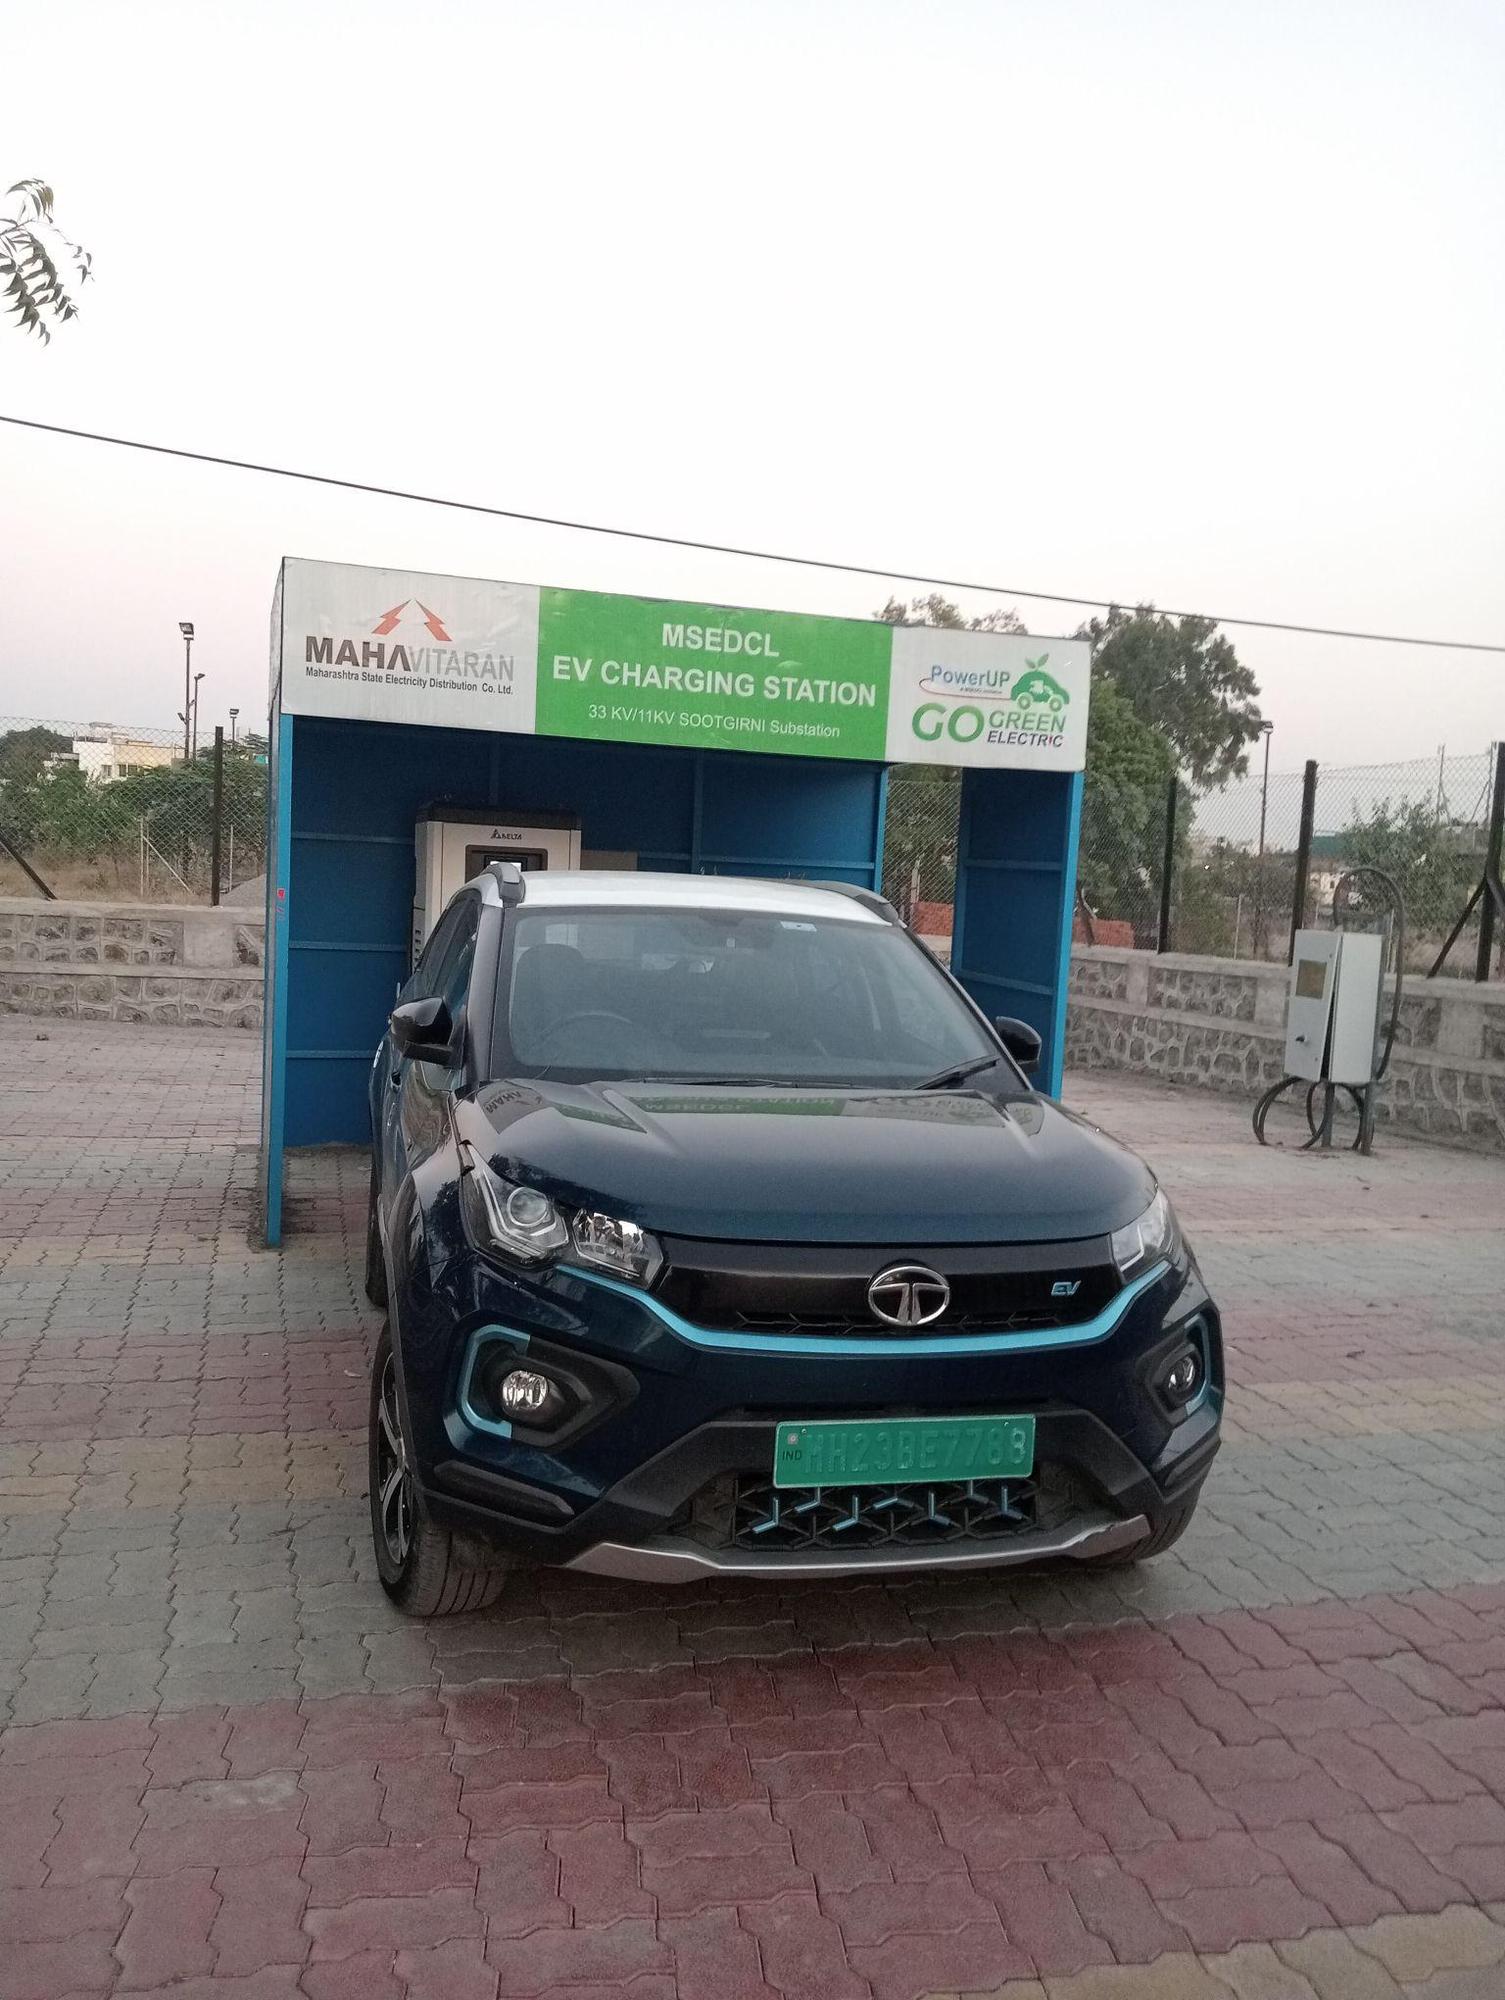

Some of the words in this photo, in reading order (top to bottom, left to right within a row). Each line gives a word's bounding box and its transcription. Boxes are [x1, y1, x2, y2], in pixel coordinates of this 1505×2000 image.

[662, 623, 780, 657] MSEDCL
[306, 636, 515, 682] MAHAVITARAN
[306, 666, 360, 681] Maharashtra
[361, 671, 383, 684] State
[386, 673, 427, 689] Electricity
[429, 677, 478, 692] Distribution
[482, 682, 496, 694] Co.
[498, 684, 514, 696] Ltd.
[553, 655, 593, 682] EV
[600, 660, 755, 697] CHARGING
[763, 676, 876, 707] STATION
[931, 665, 1011, 688] PowerUP
[588, 704, 607, 719] 33
[611, 706, 675, 726] KV/11KV
[679, 711, 766, 733] SOOTGIRNI
[770, 719, 841, 738] Substation
[911, 702, 985, 743] GO
[988, 709, 1067, 733] GREEN
[987, 730, 1065, 748] ELECTRIC
[1050, 1280, 1082, 1297] EV
[782, 1450, 802, 1461] IND
